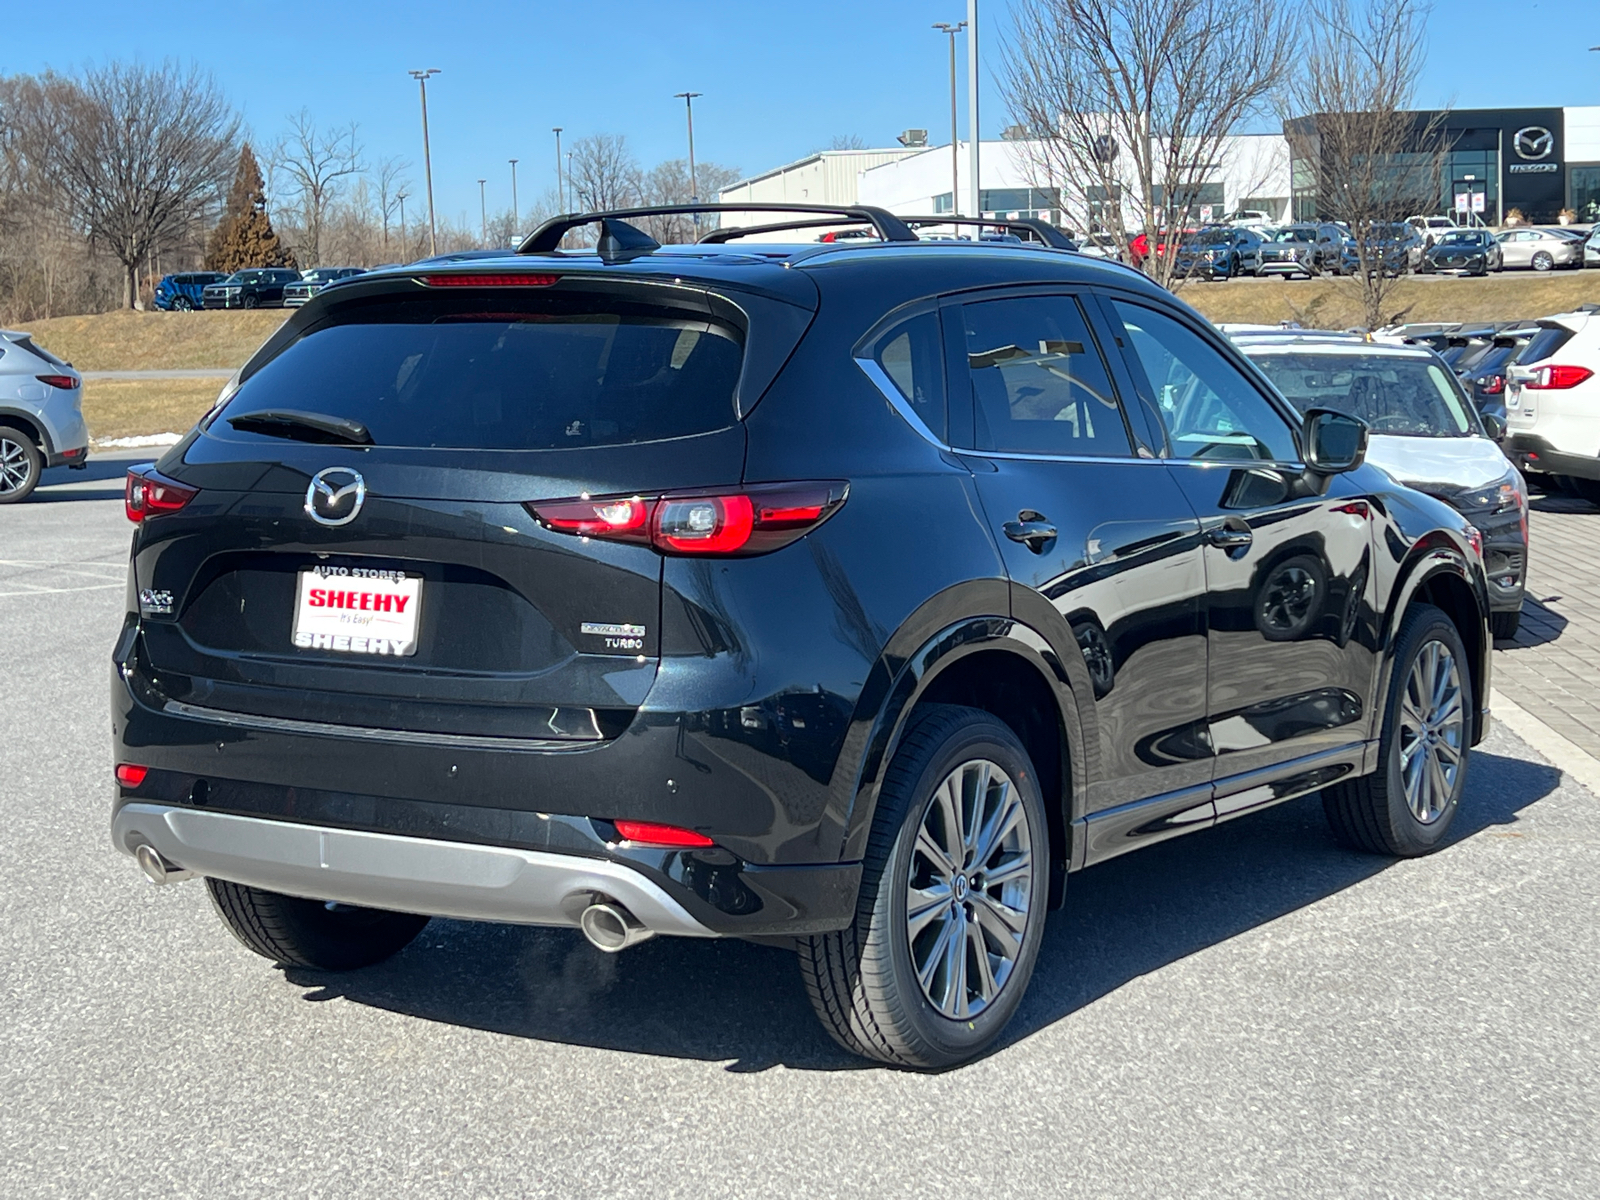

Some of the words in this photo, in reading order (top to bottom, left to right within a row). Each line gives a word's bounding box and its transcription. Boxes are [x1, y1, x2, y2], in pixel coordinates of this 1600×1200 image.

[313, 565, 349, 577] AUTO
[351, 567, 406, 581] STORES
[308, 588, 411, 613] SHEEHY
[295, 632, 410, 656] SHEEHY
[605, 637, 643, 649] TURBO
